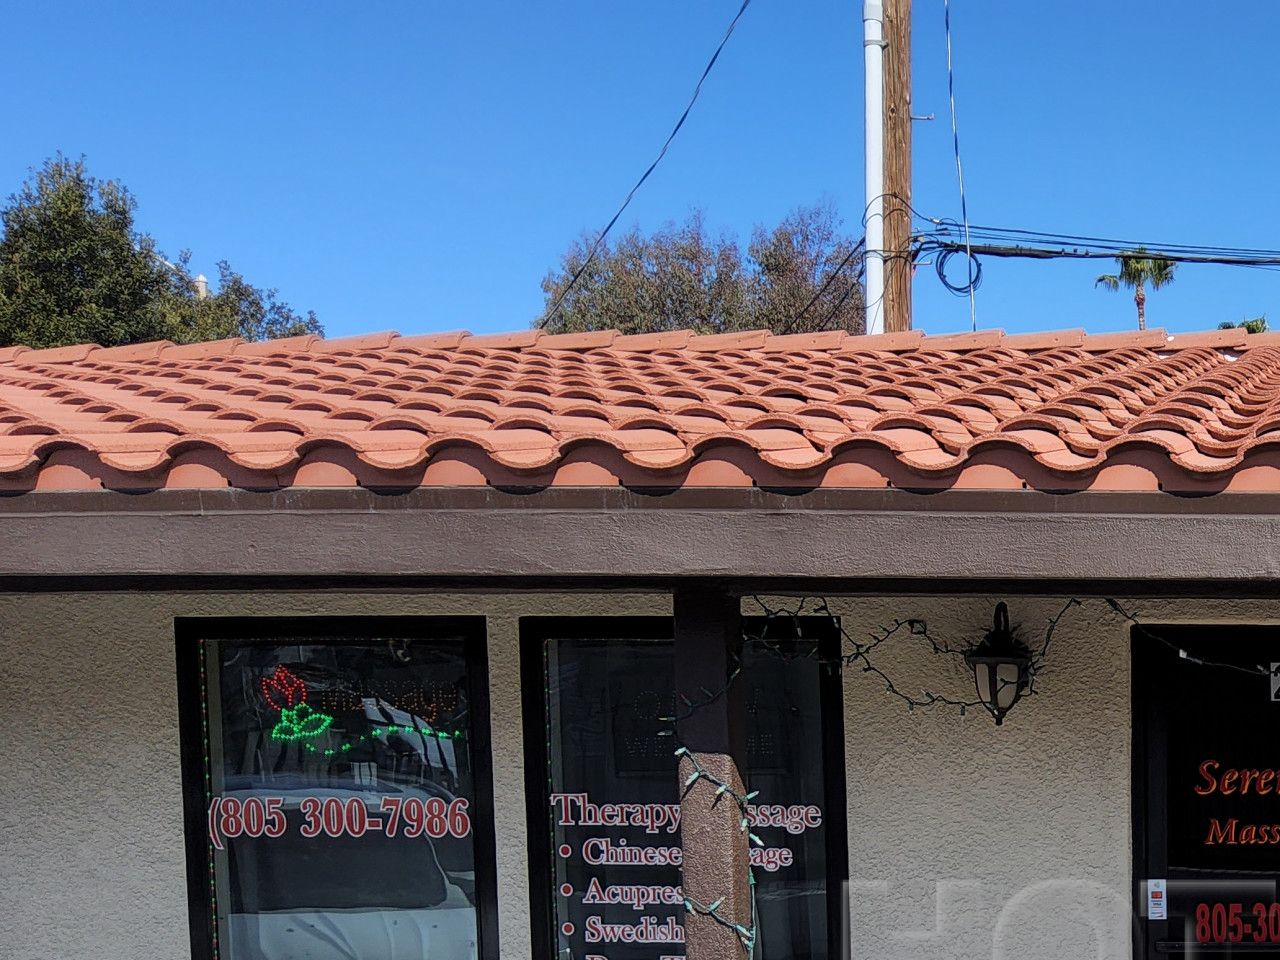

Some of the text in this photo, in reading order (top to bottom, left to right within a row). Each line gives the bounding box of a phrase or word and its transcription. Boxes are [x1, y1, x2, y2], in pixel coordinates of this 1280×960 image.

[208, 796, 470, 850] (805 300-7986
[551, 793, 822, 834] Therapy ssage
[582, 838, 683, 865] Chinese
[582, 877, 685, 910] Acupres
[585, 915, 685, 943] Swedish
